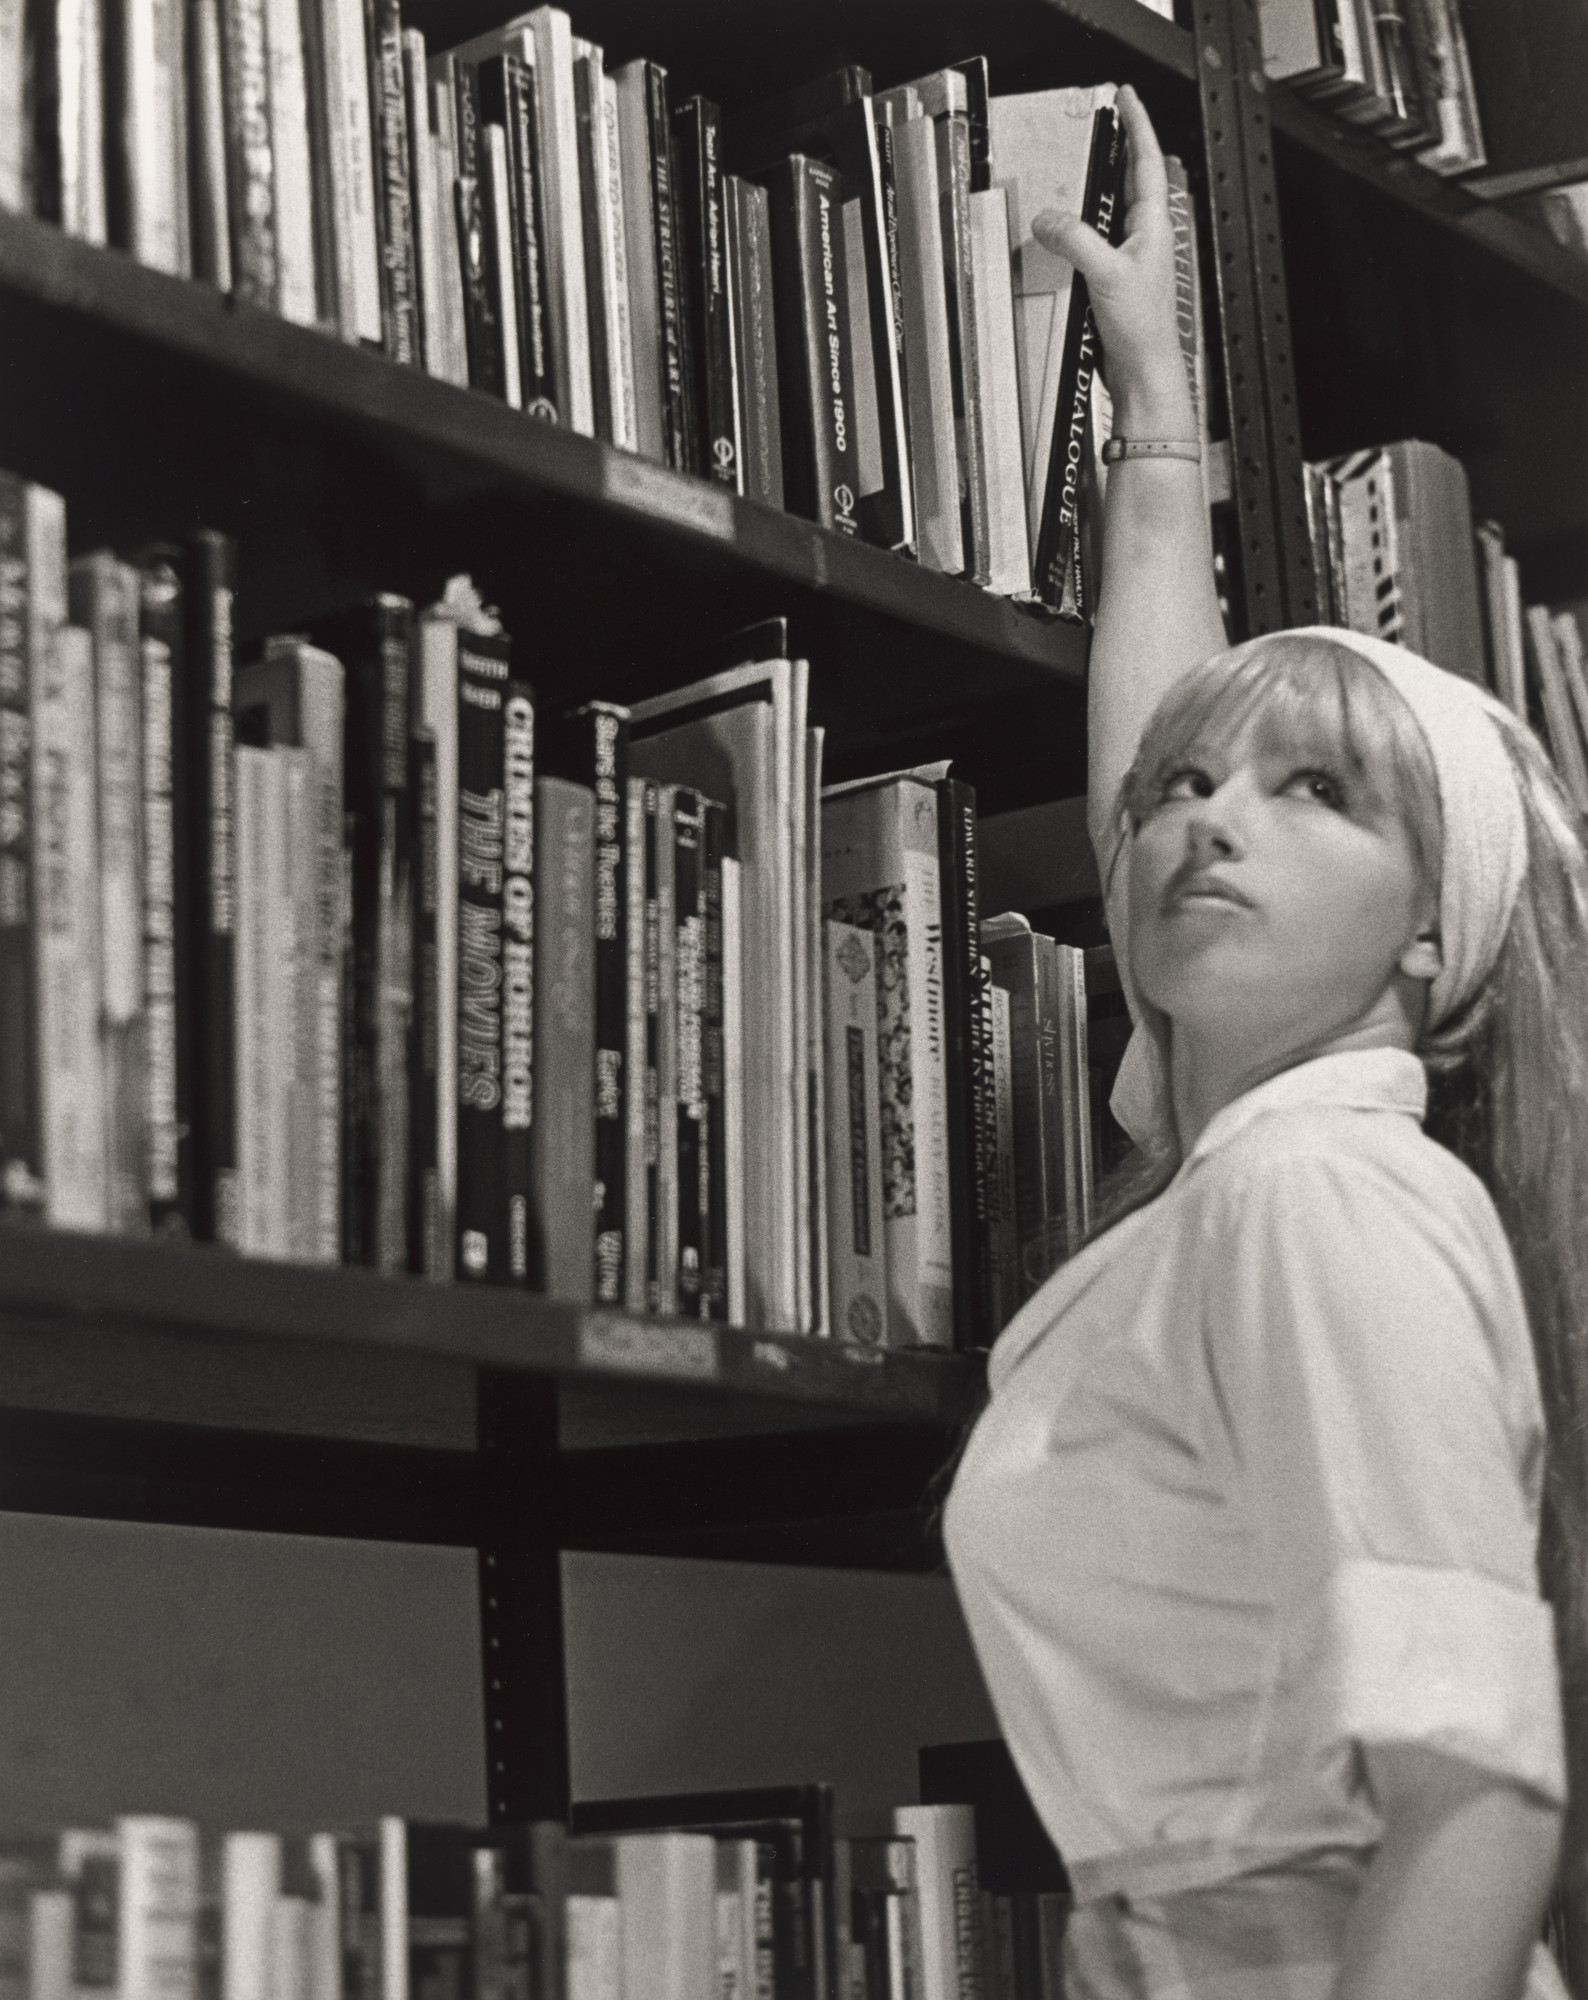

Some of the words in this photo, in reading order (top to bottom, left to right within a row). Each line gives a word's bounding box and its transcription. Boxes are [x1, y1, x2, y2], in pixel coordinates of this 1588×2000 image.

[656, 154, 668, 192] THE
[707, 163, 717, 188] Art
[819, 194, 833, 295] American
[1096, 192, 1114, 236] TH
[660, 201, 675, 322] STRUCTURE
[1168, 183, 1192, 338] MAXFIELD
[826, 299, 837, 330] Art
[669, 351, 681, 393] ART
[828, 333, 841, 394] Since
[833, 398, 846, 452] 1900
[1060, 367, 1091, 527] DIALOGUE
[461, 789, 504, 893] THE
[964, 807, 974, 883] EDWARD
[504, 875, 532, 941] OF
[967, 889, 978, 976] STEICHEN
[458, 898, 502, 1109] MOVIES
[503, 938, 532, 1128] HORROR
[971, 1013, 980, 1047] LIFE
[973, 1084, 985, 1220] PHOTOGRAPHY
